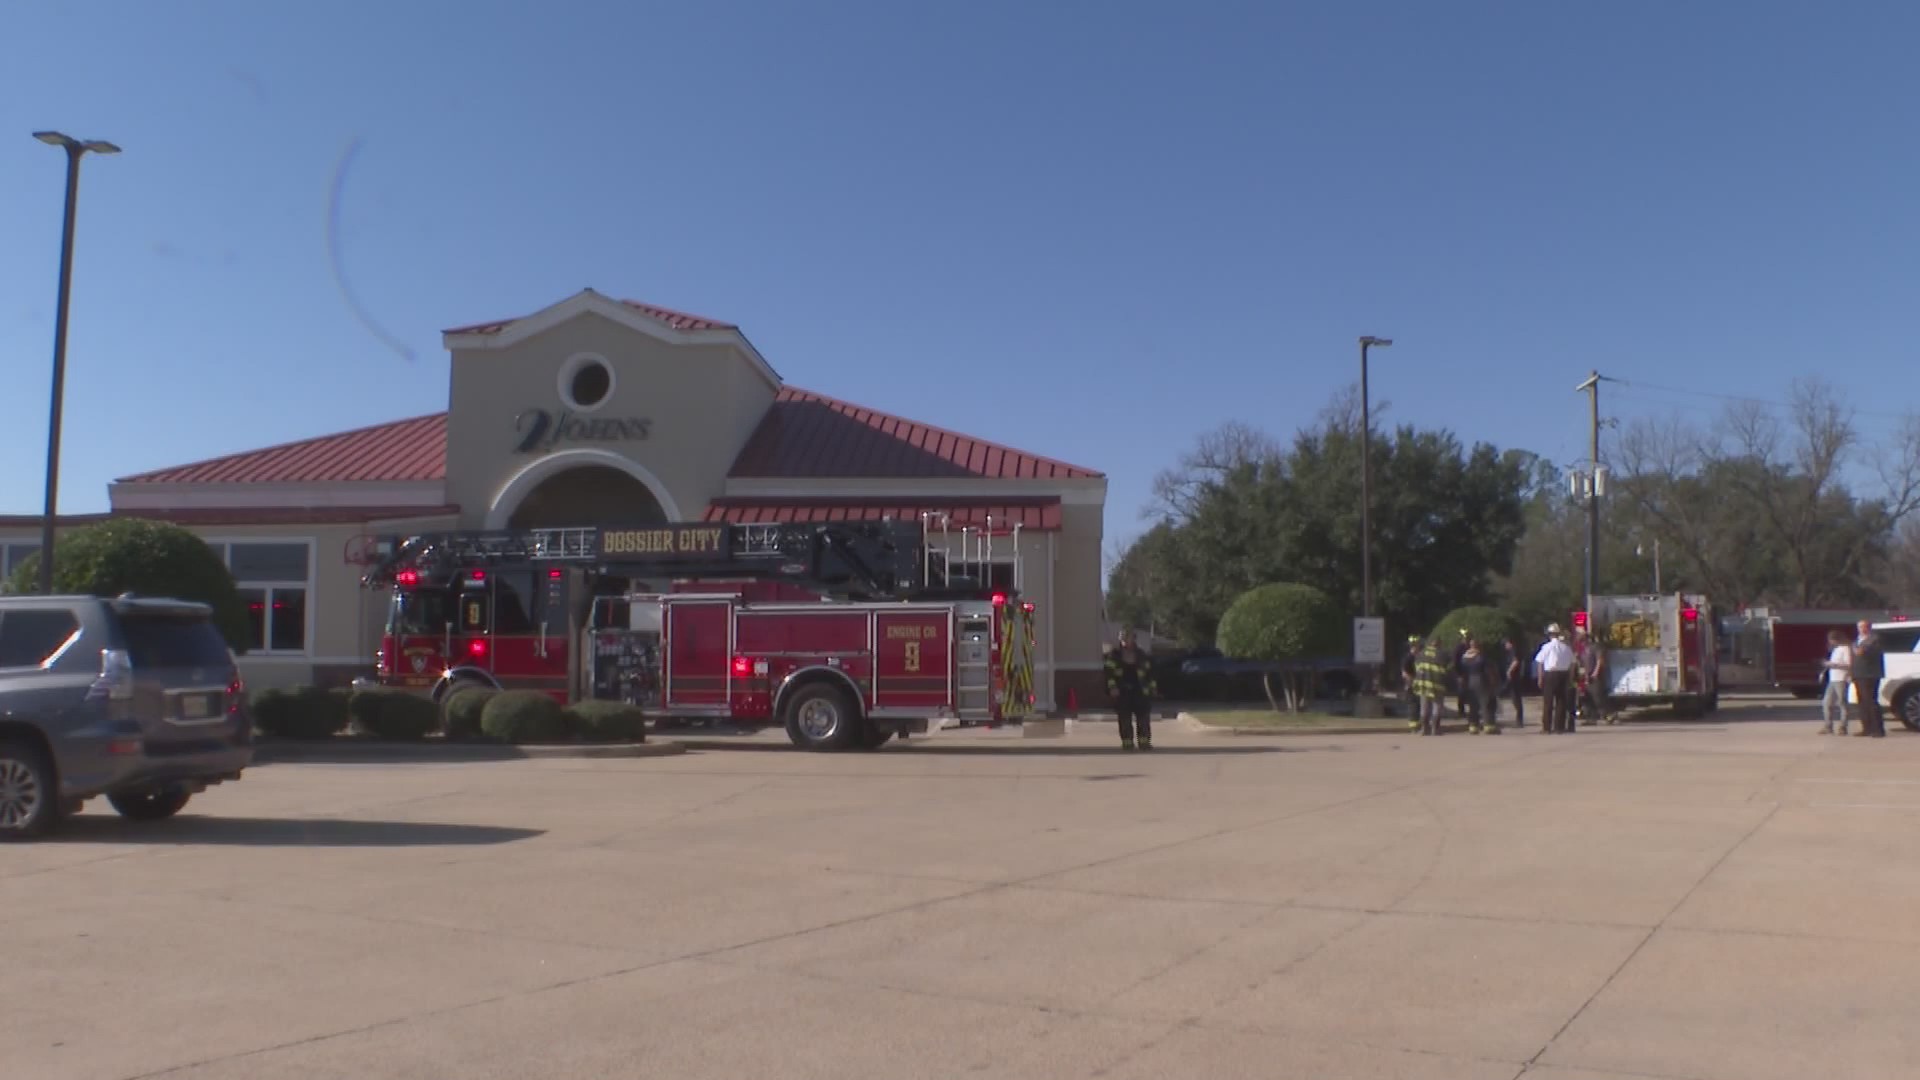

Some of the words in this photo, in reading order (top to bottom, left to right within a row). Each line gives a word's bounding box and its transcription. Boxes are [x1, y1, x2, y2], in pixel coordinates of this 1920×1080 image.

[604, 530, 674, 553] BOSSIER
[680, 528, 721, 551] CITY
[886, 626, 920, 639] ENGINE
[905, 641, 920, 671] 9
